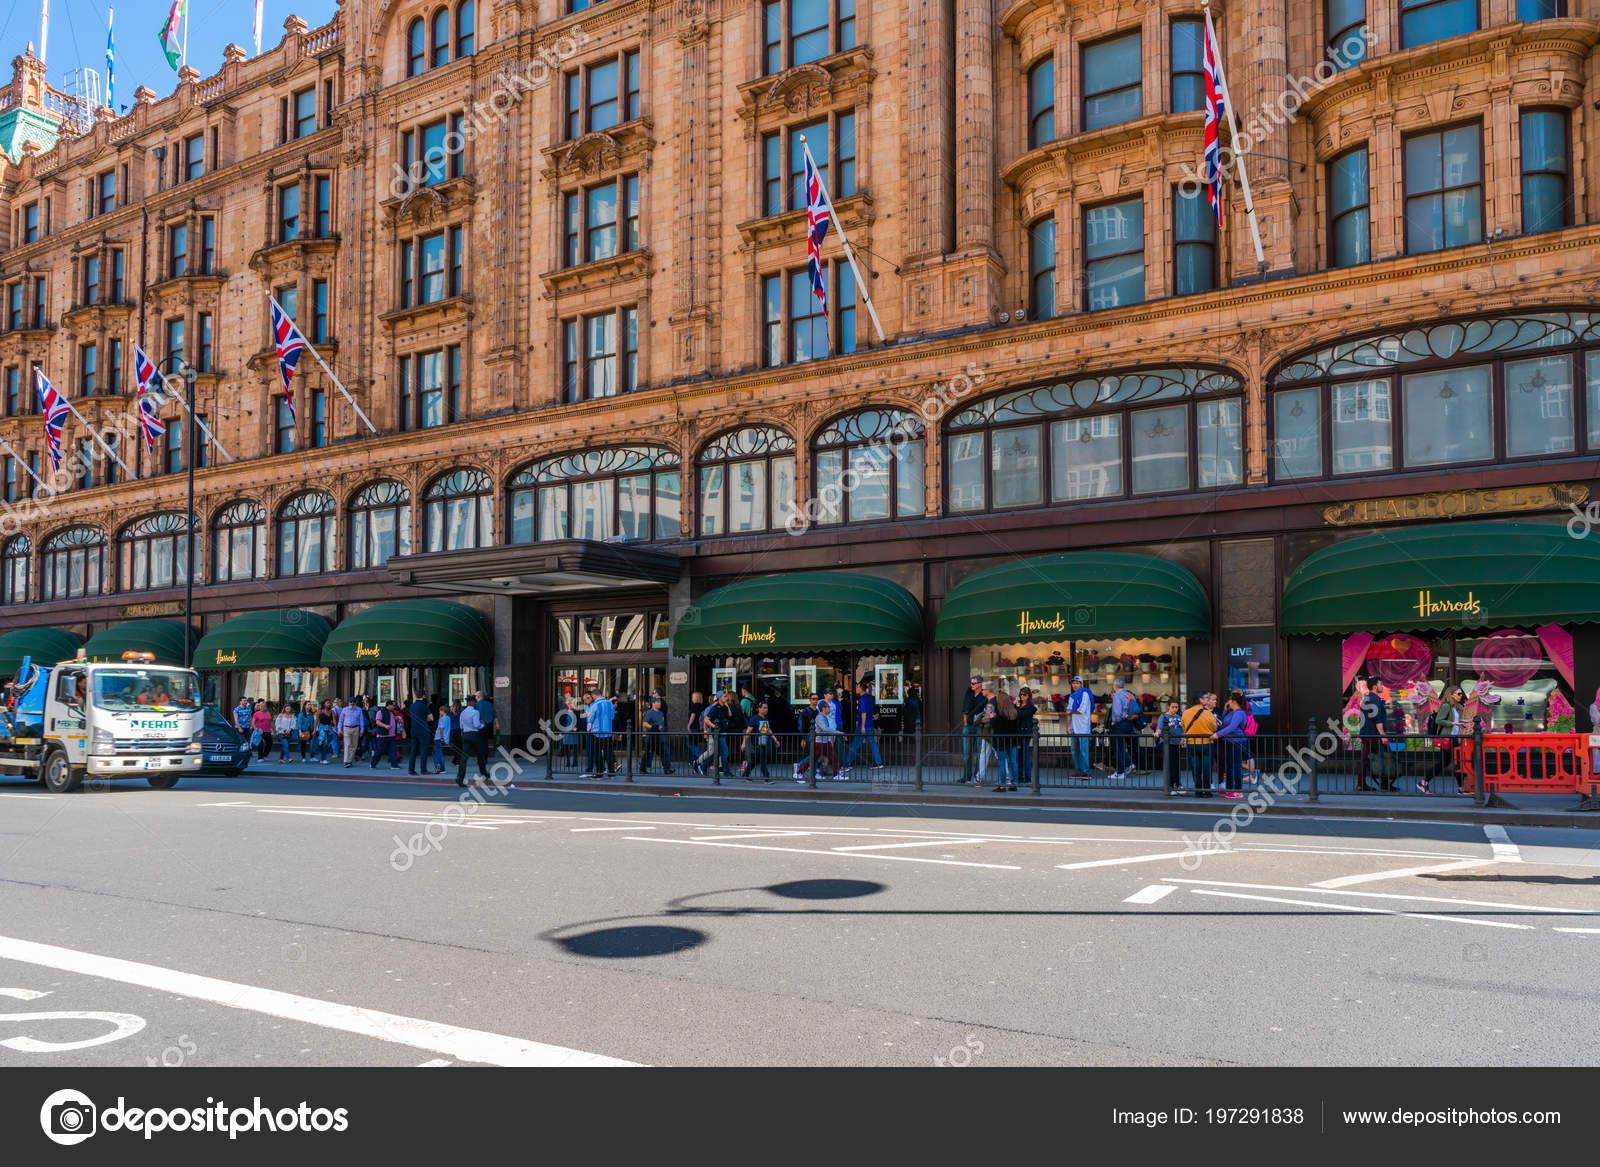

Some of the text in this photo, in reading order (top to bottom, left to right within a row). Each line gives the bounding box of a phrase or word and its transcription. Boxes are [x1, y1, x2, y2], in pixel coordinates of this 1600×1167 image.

[1413, 590, 1480, 617] Harrods
[1017, 611, 1065, 634] Harrods
[738, 624, 776, 645] Harrods
[355, 641, 380, 658] Harrods
[1230, 647, 1253, 656] LIVE
[141, 720, 179, 729] FERNS
